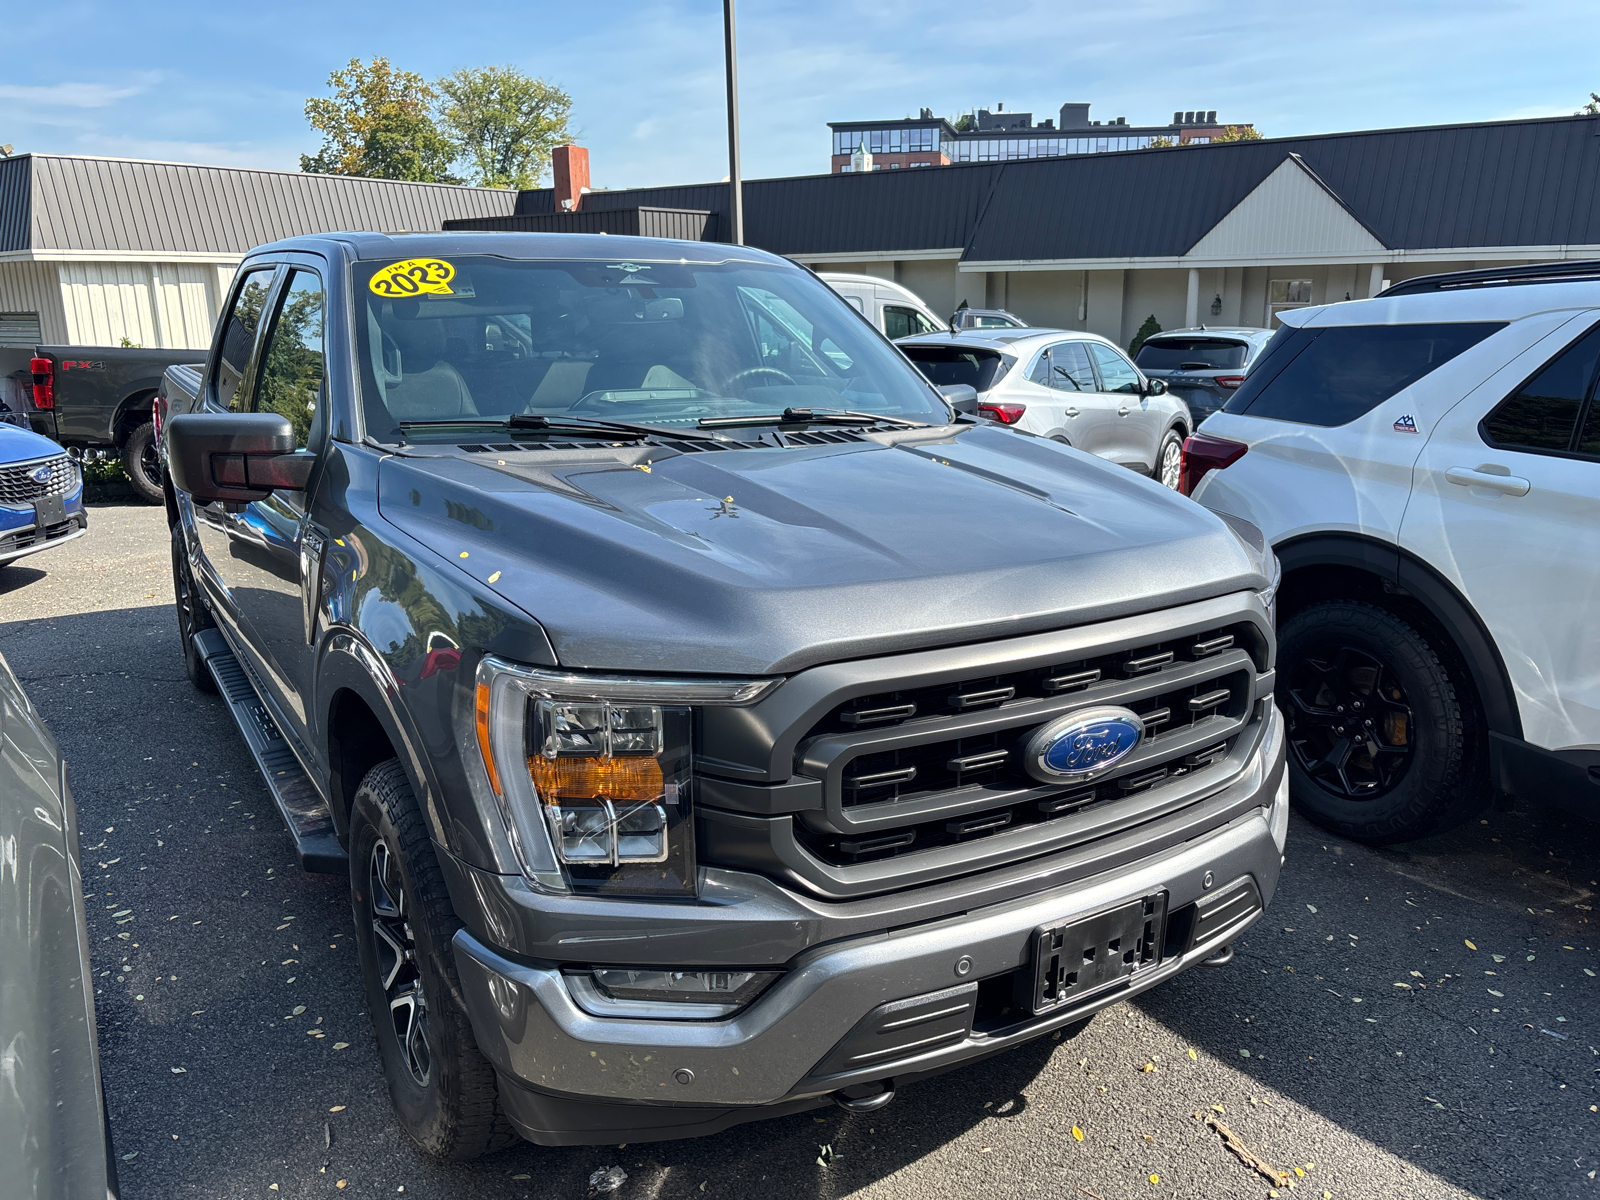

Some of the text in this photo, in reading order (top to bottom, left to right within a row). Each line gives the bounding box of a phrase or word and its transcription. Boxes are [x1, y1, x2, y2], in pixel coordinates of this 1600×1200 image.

[374, 262, 451, 295] 2023
[386, 264, 405, 274] I'M
[63, 361, 106, 370] FX4
[1067, 729, 1122, 767] Ford
